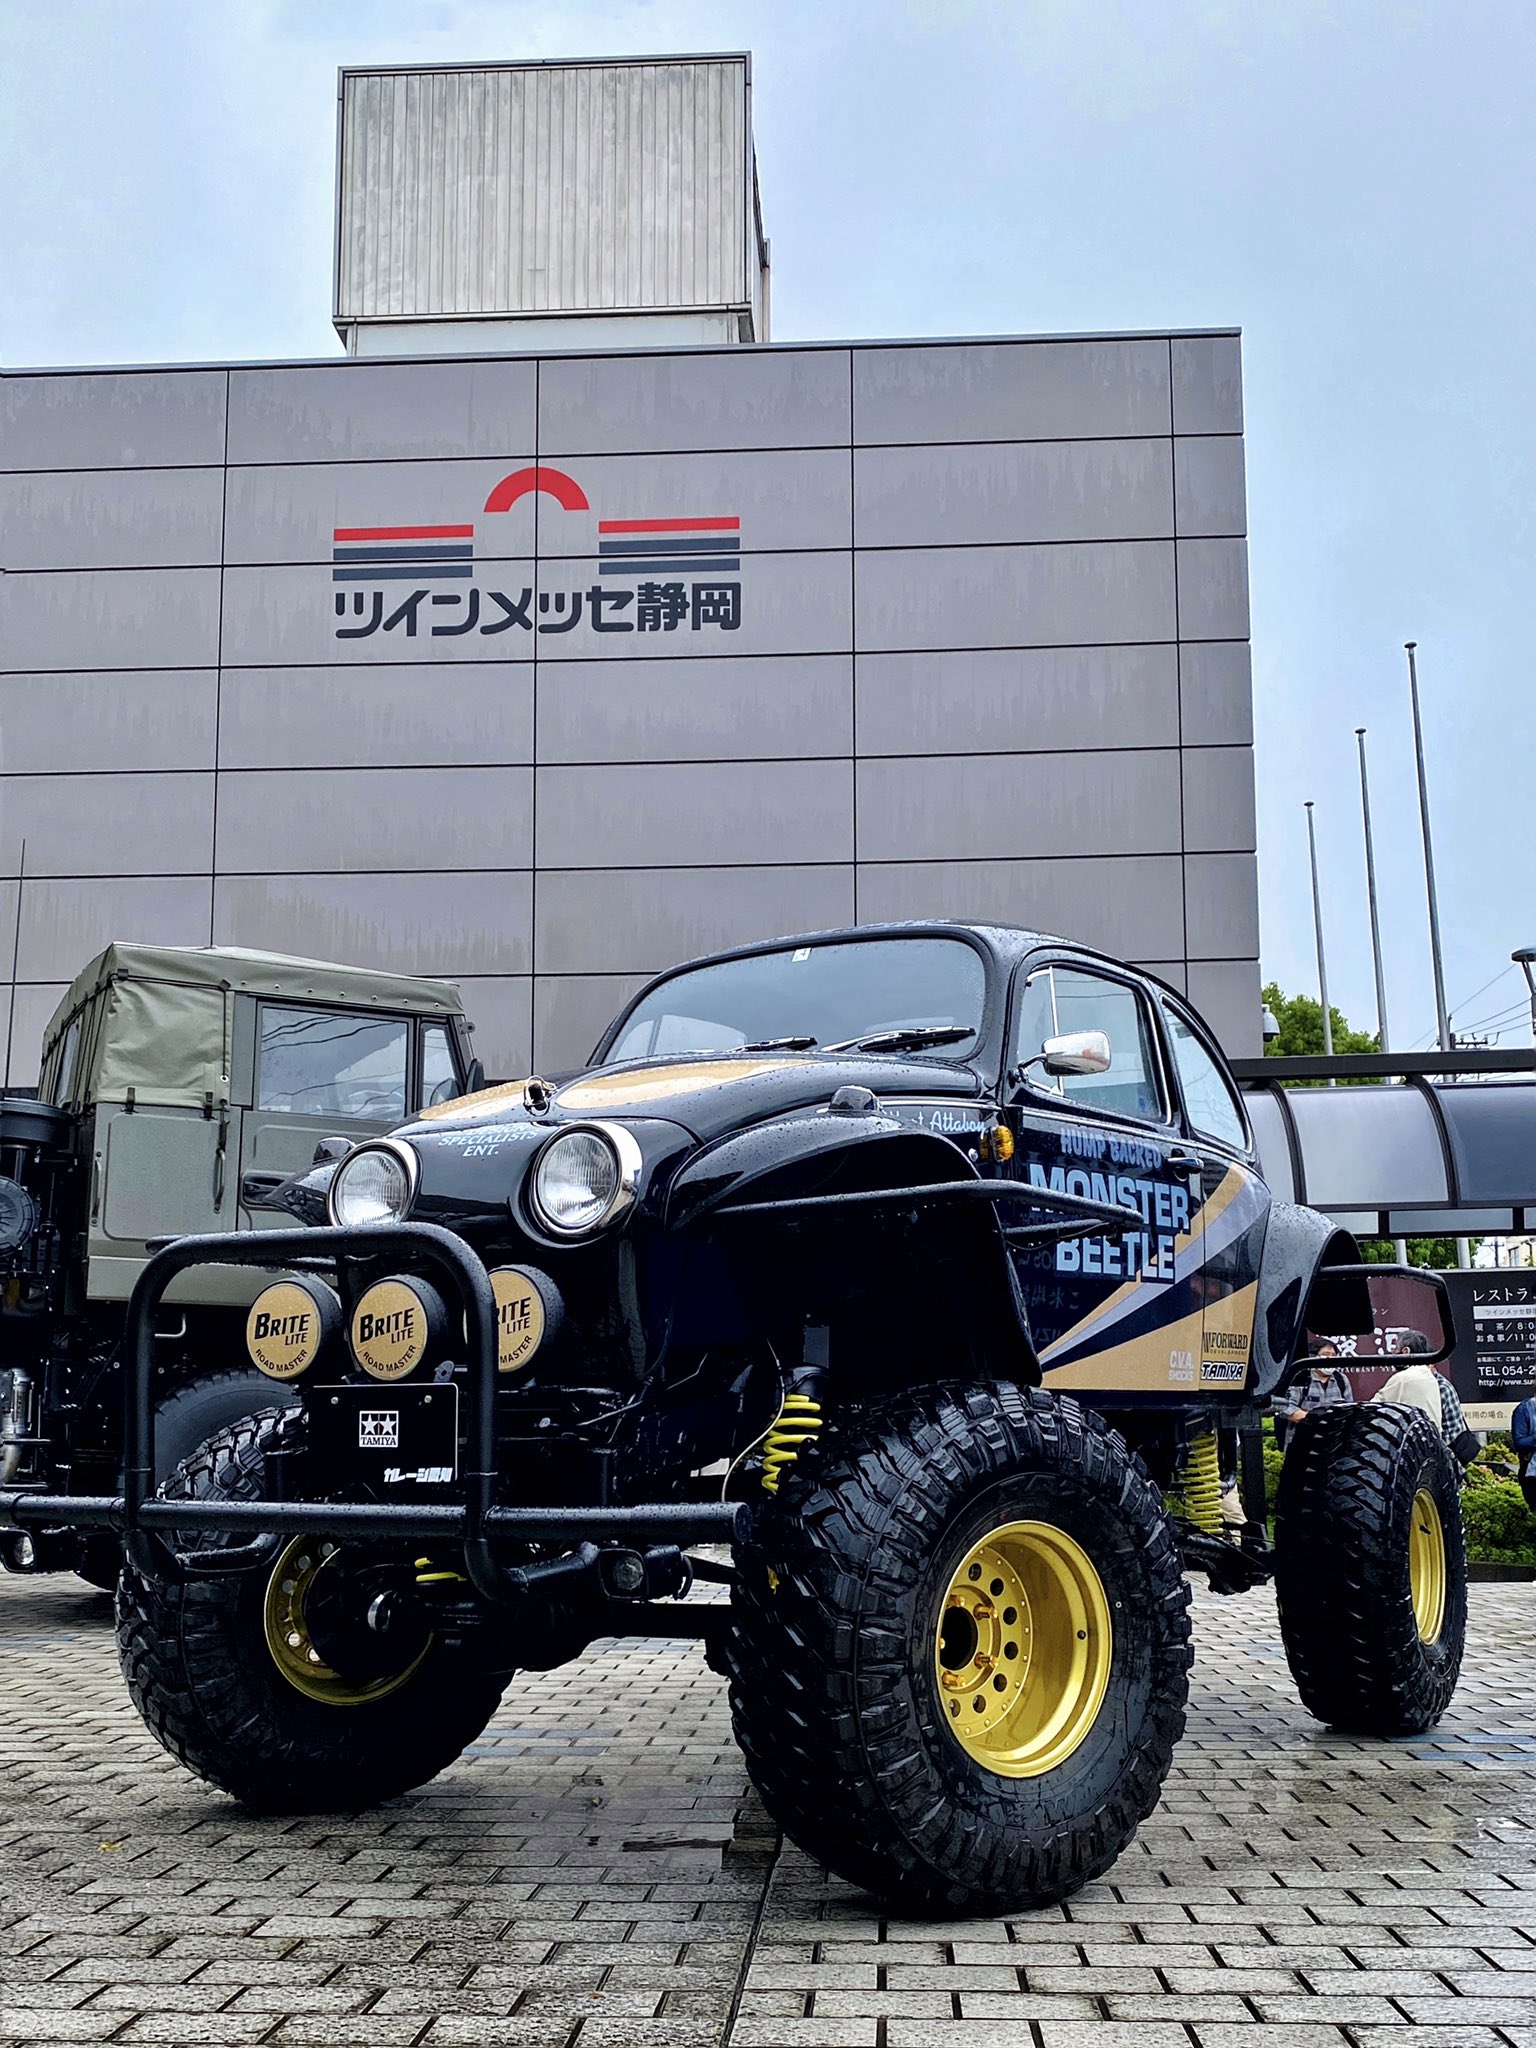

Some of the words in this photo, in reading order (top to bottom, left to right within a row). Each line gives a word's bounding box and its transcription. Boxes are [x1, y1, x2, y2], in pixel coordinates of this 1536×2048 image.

[335, 582, 741, 639] ツインメッセ静岡
[438, 1130, 539, 1146] SPECIALISTS
[1060, 1128, 1106, 1159] HUMP
[1108, 1137, 1162, 1169] BACKED
[462, 1144, 500, 1157] ENT.
[1029, 1163, 1190, 1231] MONSTER
[1056, 1232, 1175, 1279] BEETLE
[1473, 1287, 1536, 1302] レストラ
[496, 1296, 531, 1324] ITE
[254, 1312, 311, 1340] BRITE
[360, 1307, 415, 1344] BRITE
[391, 1327, 414, 1344] LITE
[507, 1317, 531, 1334] LITE
[285, 1332, 308, 1346] LITE
[500, 1335, 532, 1363] MASTER
[1210, 1332, 1248, 1350] FORWARD
[255, 1348, 275, 1370] ROAD
[276, 1349, 308, 1372] MASTER
[363, 1351, 384, 1371] ROAD
[386, 1345, 416, 1372] MASTER
[1201, 1362, 1246, 1379] TAMIYA
[1478, 1366, 1500, 1376] TEL
[1502, 1365, 1536, 1375] 054-2
[360, 1436, 397, 1446] TAMIYA
